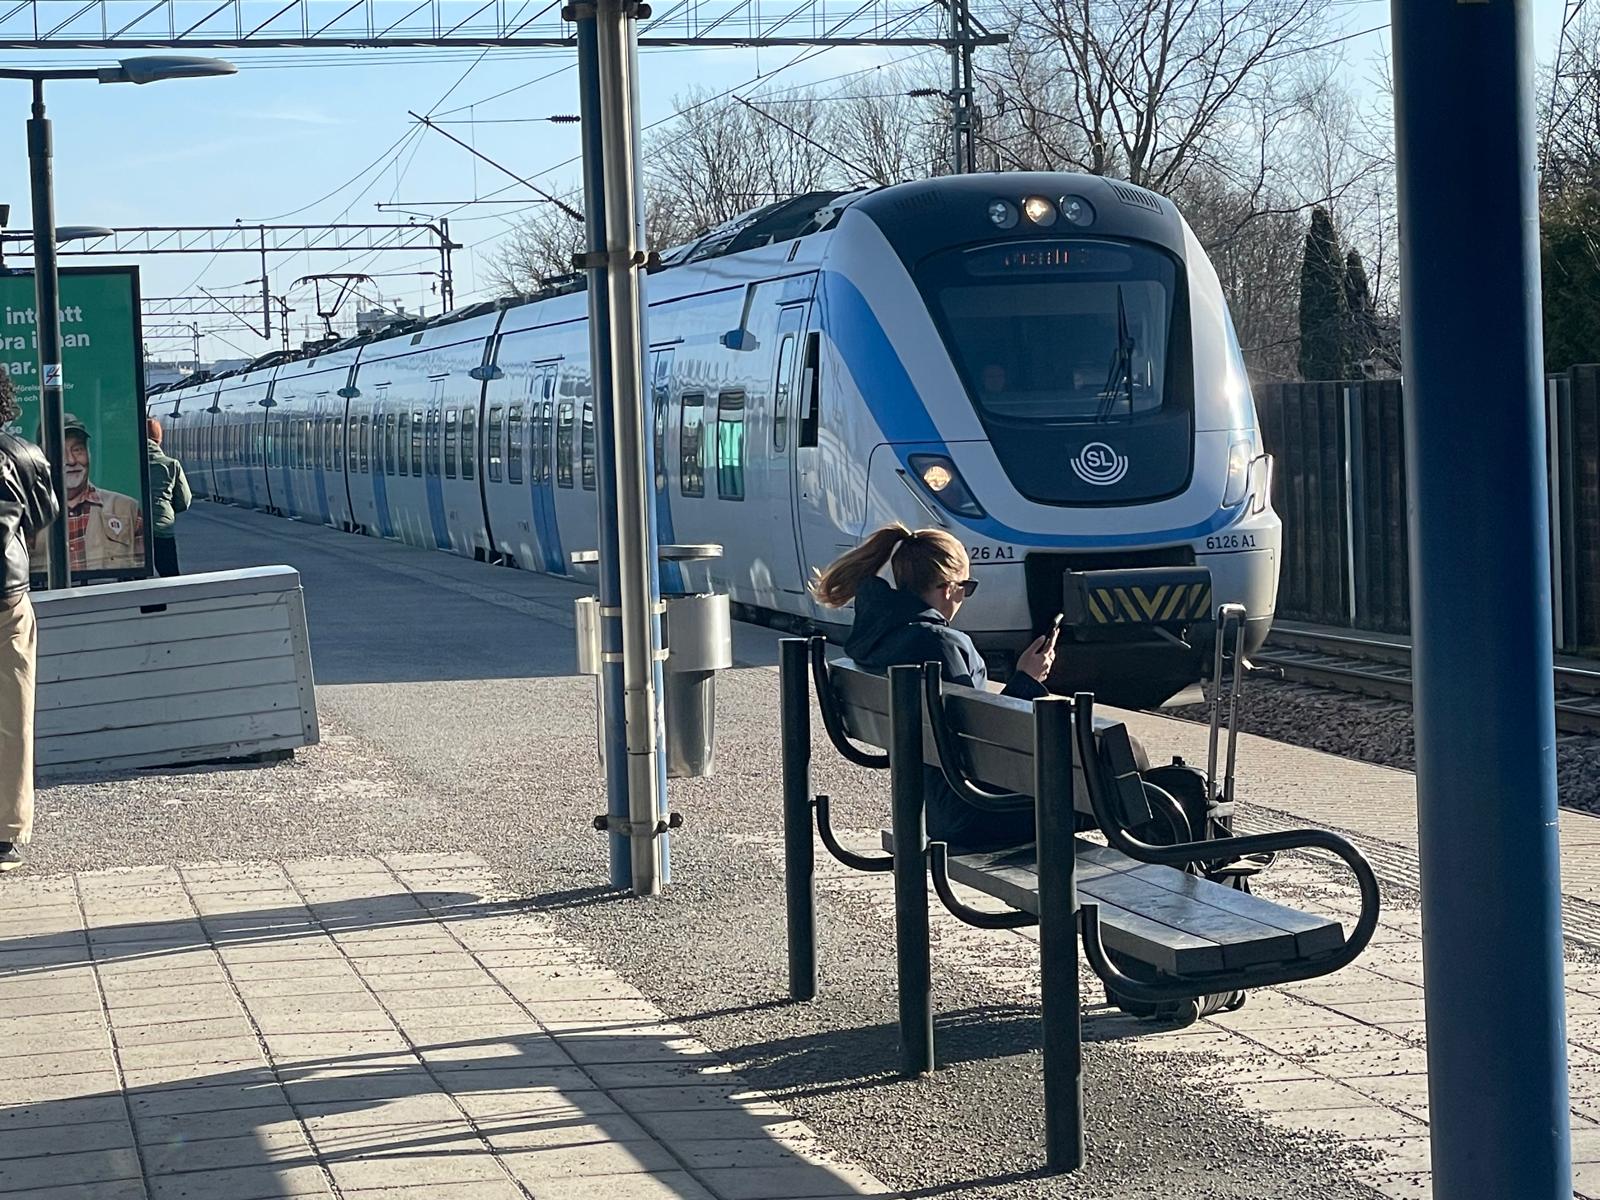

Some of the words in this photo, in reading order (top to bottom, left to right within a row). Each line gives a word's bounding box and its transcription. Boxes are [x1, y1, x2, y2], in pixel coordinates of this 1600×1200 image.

[1086, 450, 1113, 467] SL
[1206, 534, 1239, 549] 6126
[1241, 534, 1256, 548] A1
[969, 546, 990, 560] 26
[995, 545, 1015, 559] A1
